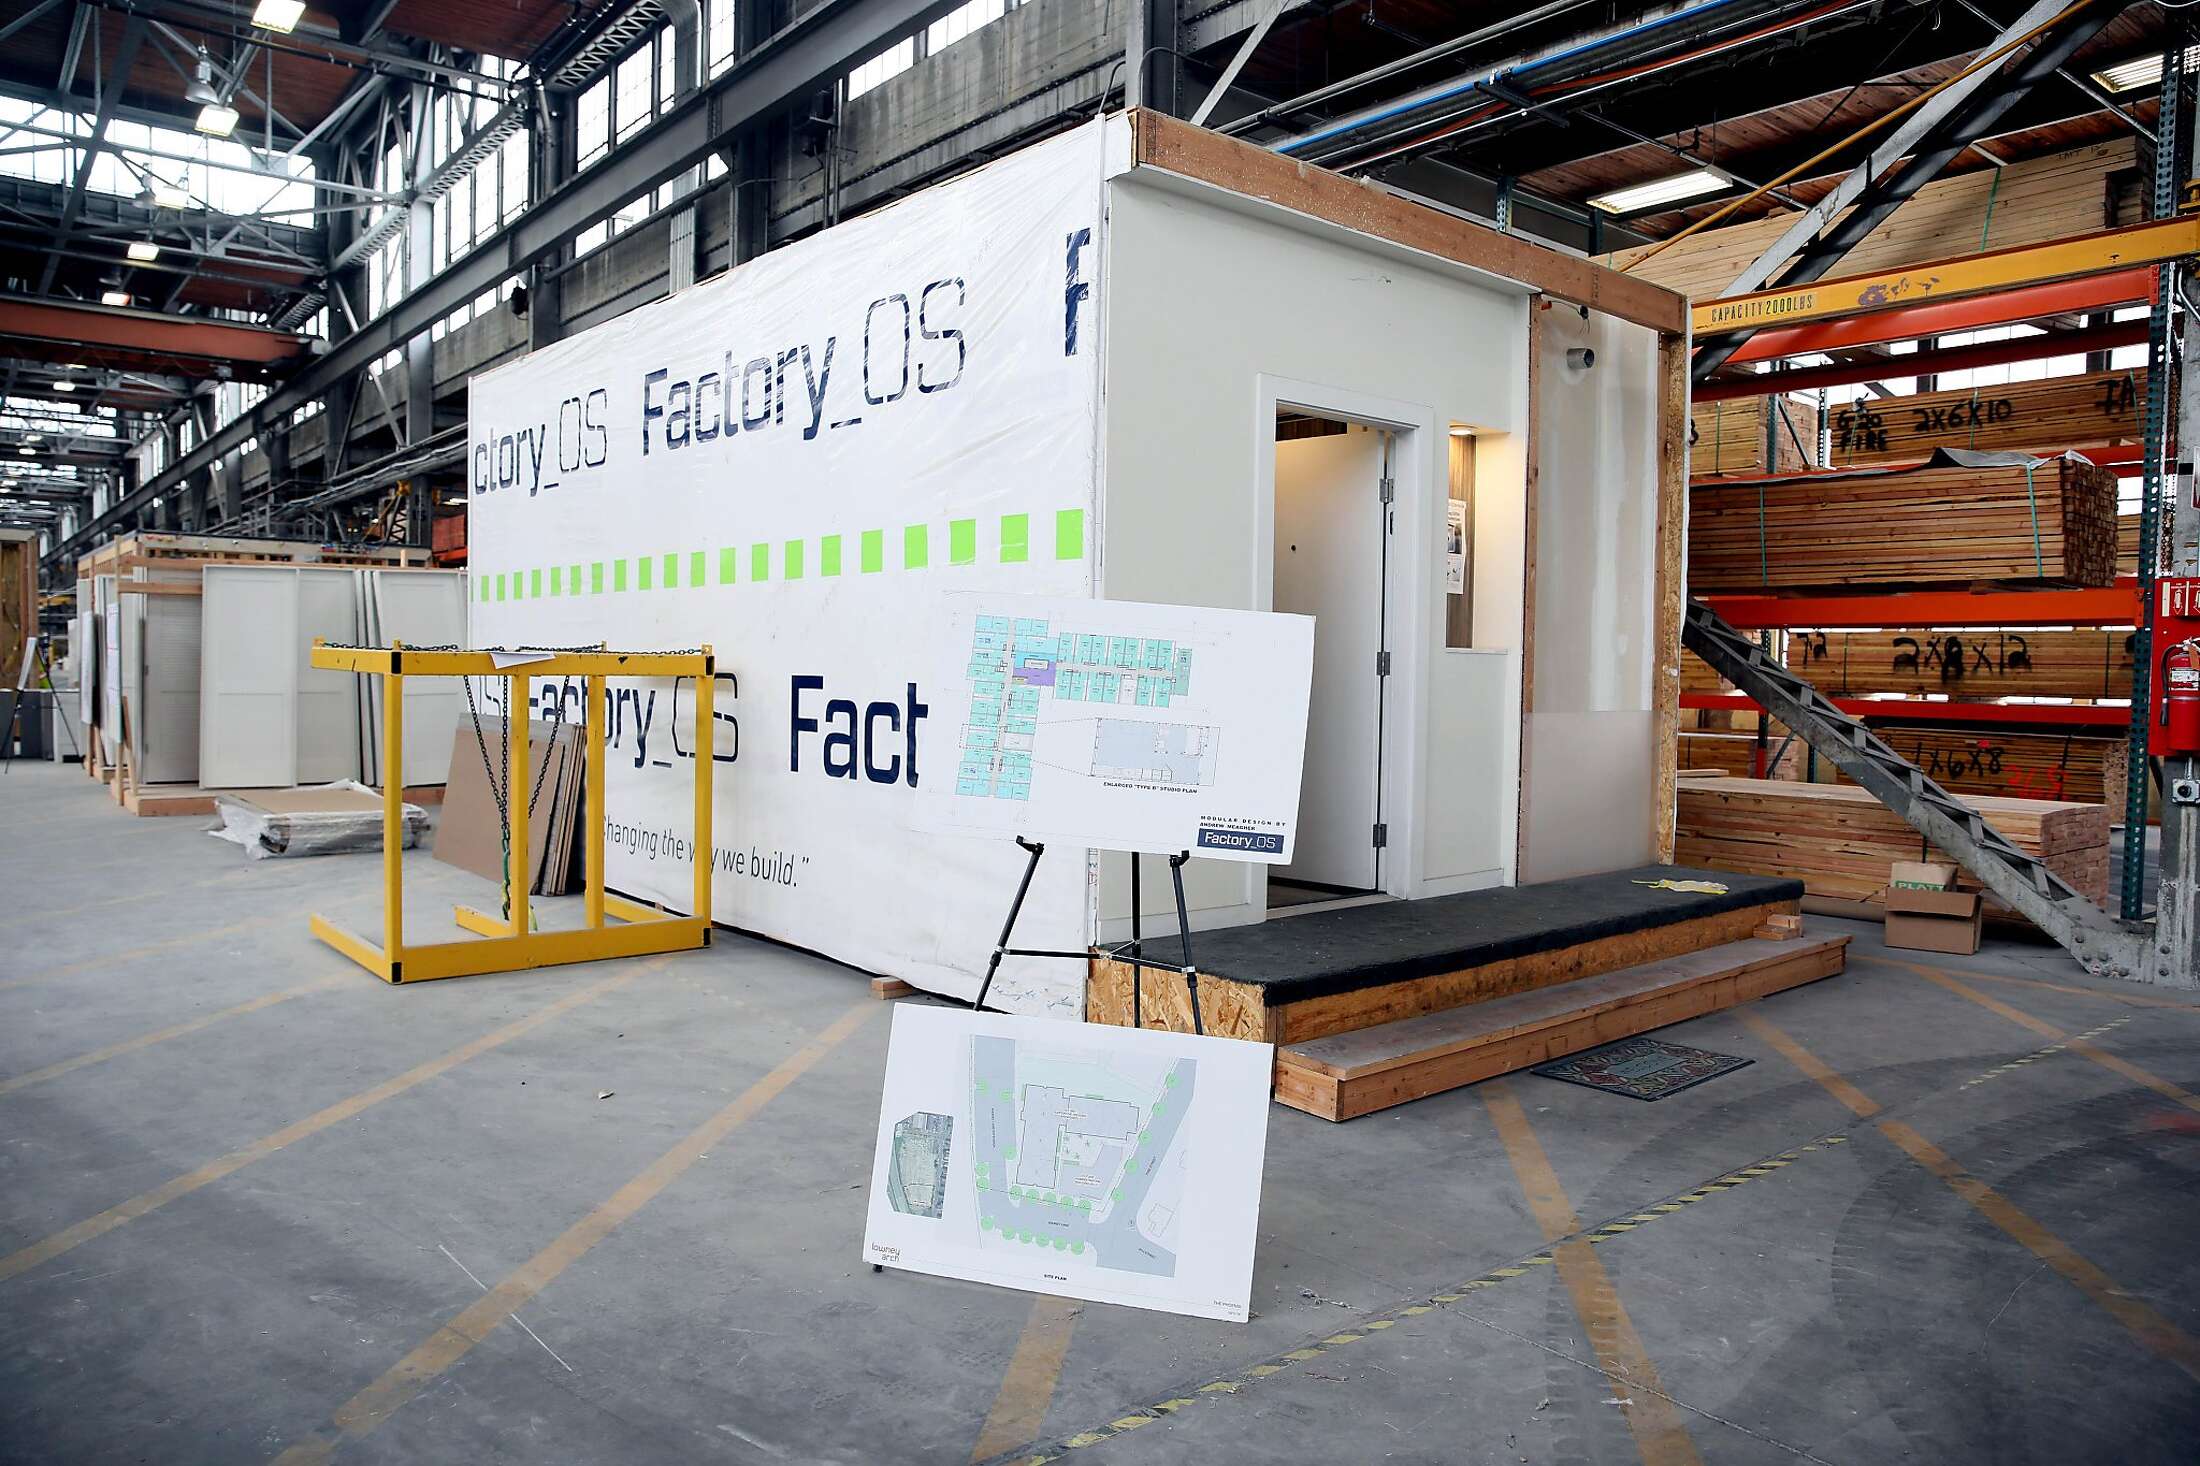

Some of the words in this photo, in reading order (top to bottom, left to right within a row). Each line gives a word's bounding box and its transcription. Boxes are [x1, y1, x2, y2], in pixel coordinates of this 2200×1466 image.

[1711, 302, 1762, 323] CAPACITY
[643, 277, 967, 457] Factory_OS
[790, 674, 929, 789] Fact
[1200, 815, 1238, 823] MODULAR
[1242, 818, 1272, 826] DESIGN
[1204, 831, 1276, 849] Factory_OS
[603, 814, 658, 860] hanging
[662, 828, 684, 860] the
[722, 848, 745, 874] we
